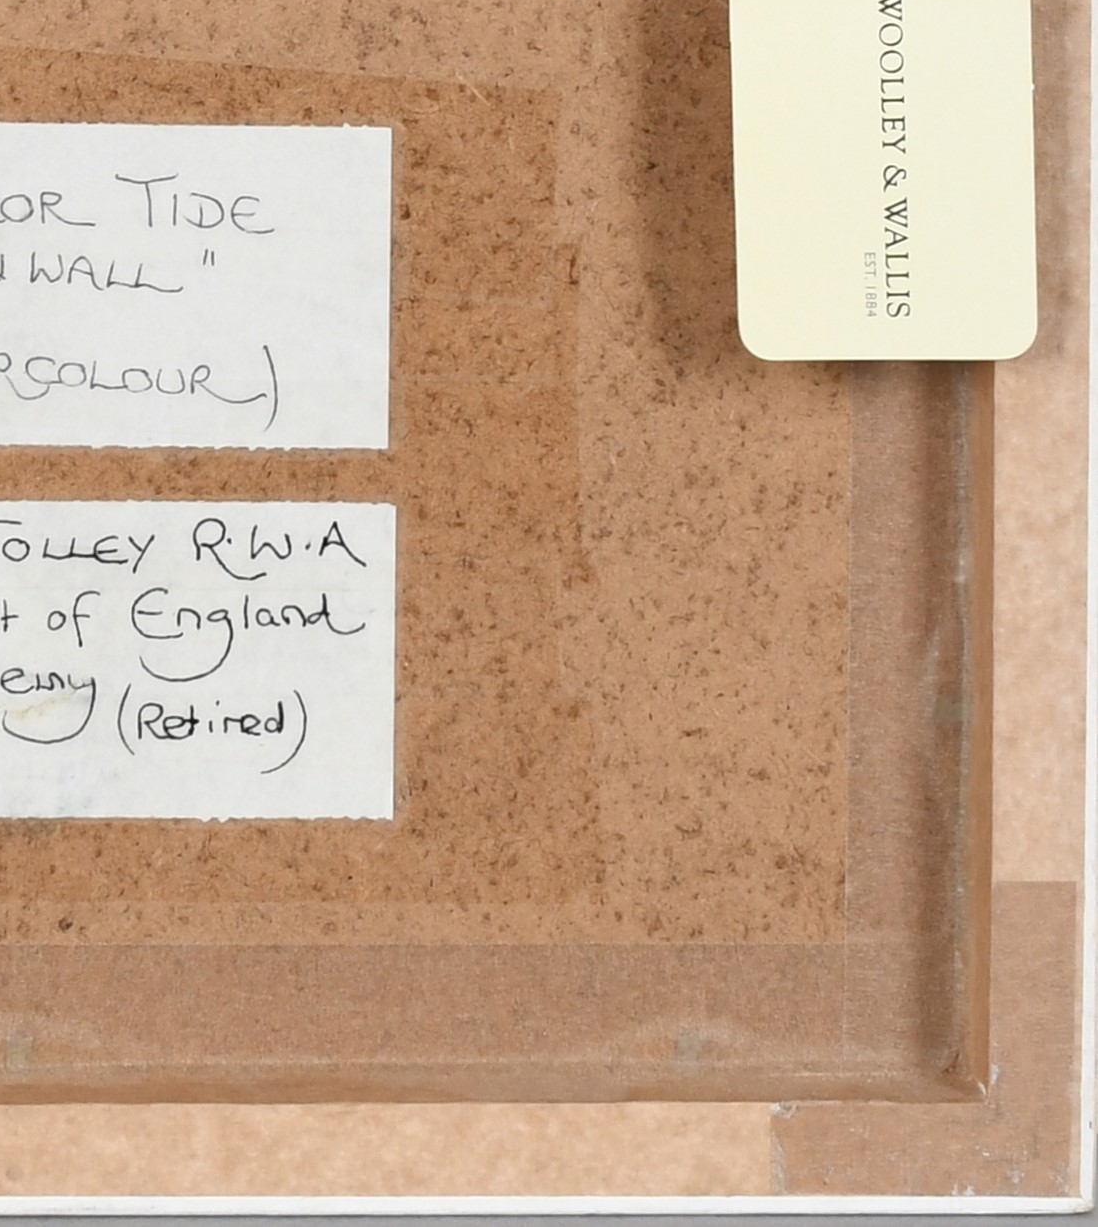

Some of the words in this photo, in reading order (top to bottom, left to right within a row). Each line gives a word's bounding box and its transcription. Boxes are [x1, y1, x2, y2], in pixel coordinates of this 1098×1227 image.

[115, 173, 276, 234] TIDE
[882, 164, 907, 192] &
[863, 251, 877, 281] EST.
[883, 197, 911, 319] WALLIS
[865, 285, 878, 318] 1884
[46, 590, 102, 648] of
[129, 587, 366, 682] England
[117, 683, 308, 774] (Retired)
